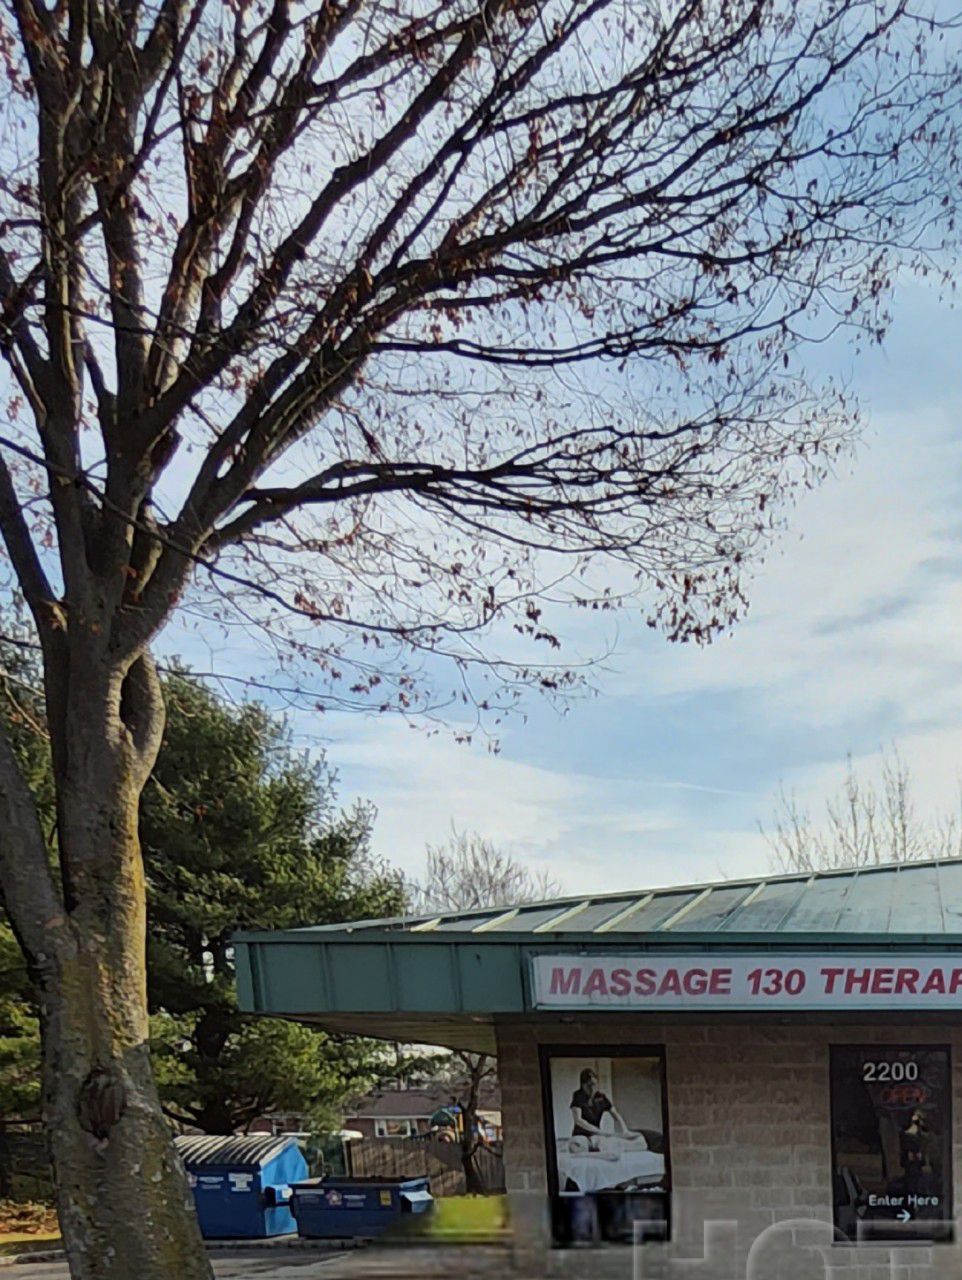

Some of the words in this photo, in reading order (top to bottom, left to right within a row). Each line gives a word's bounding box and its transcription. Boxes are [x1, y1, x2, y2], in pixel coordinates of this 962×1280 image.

[550, 967, 732, 995] MASSAGE
[746, 967, 806, 995] 130
[862, 1061, 919, 1081] 2200
[868, 1194, 905, 1207] Enter
[907, 1194, 939, 1207] Here
